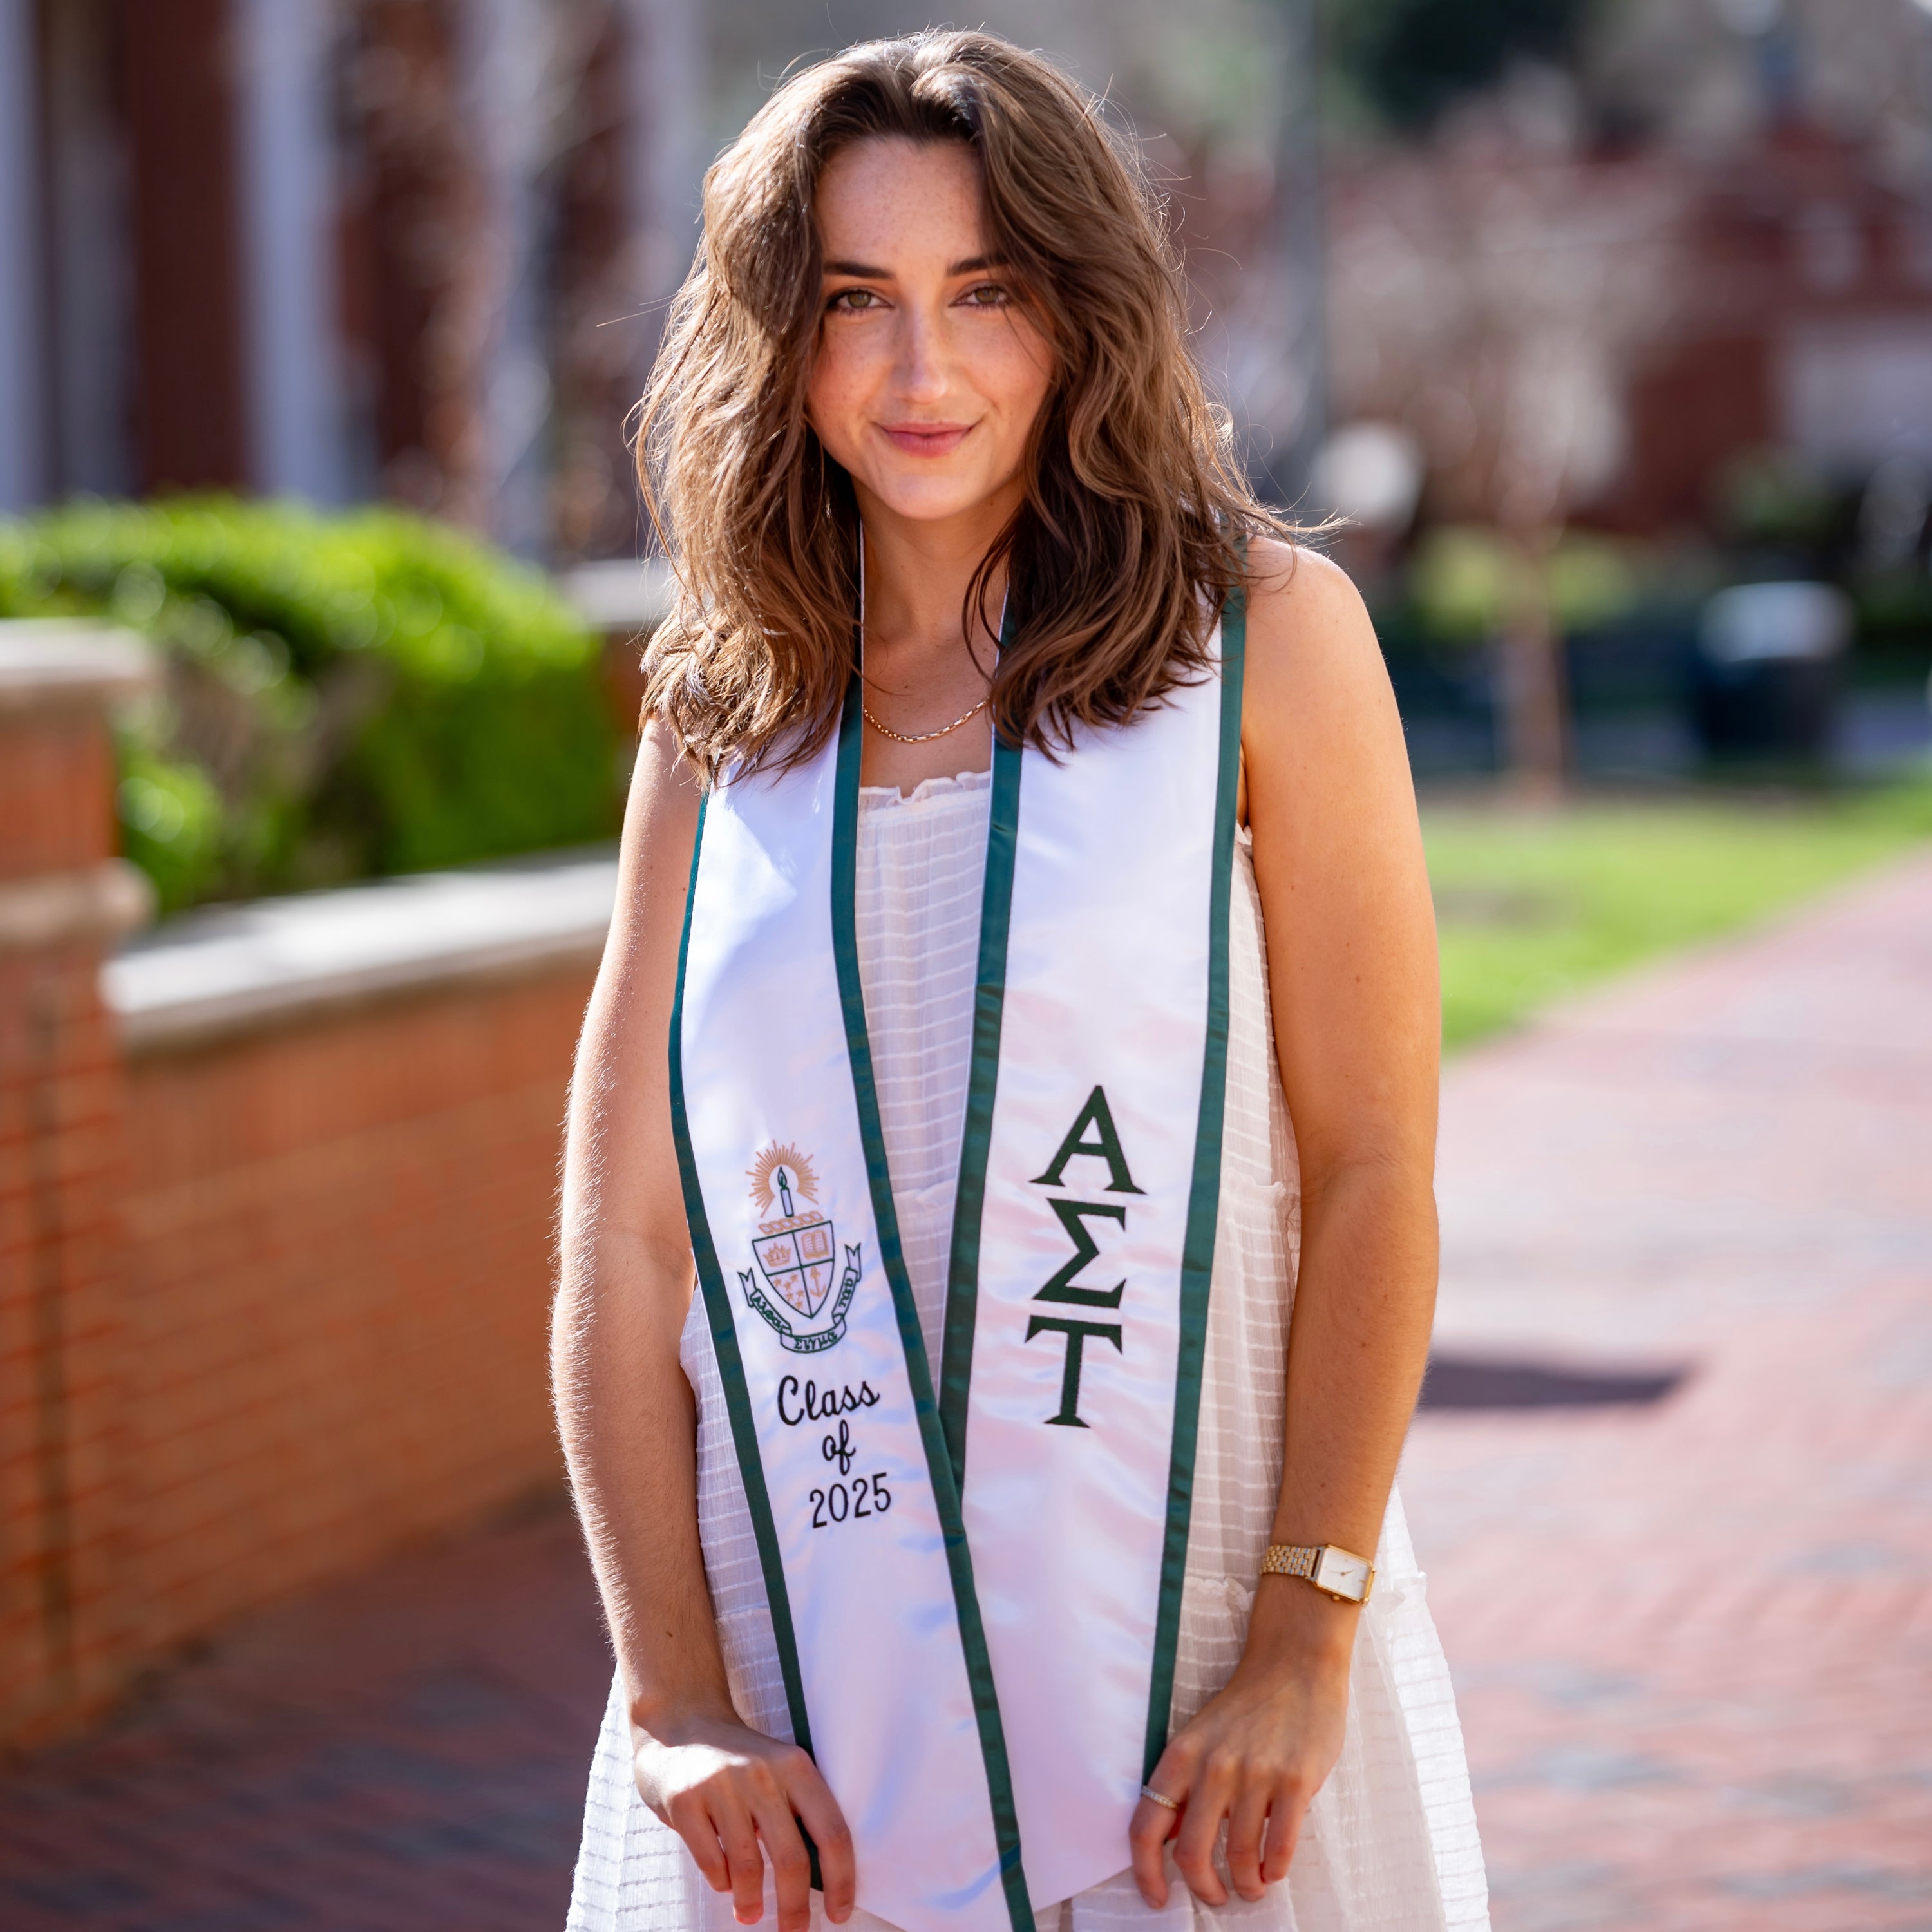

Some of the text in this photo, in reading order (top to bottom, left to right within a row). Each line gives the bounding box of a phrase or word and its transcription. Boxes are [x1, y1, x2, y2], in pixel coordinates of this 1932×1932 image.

[777, 1375, 880, 1426] Class
[822, 1419, 857, 1476] of
[809, 1472, 891, 1528] 2025
